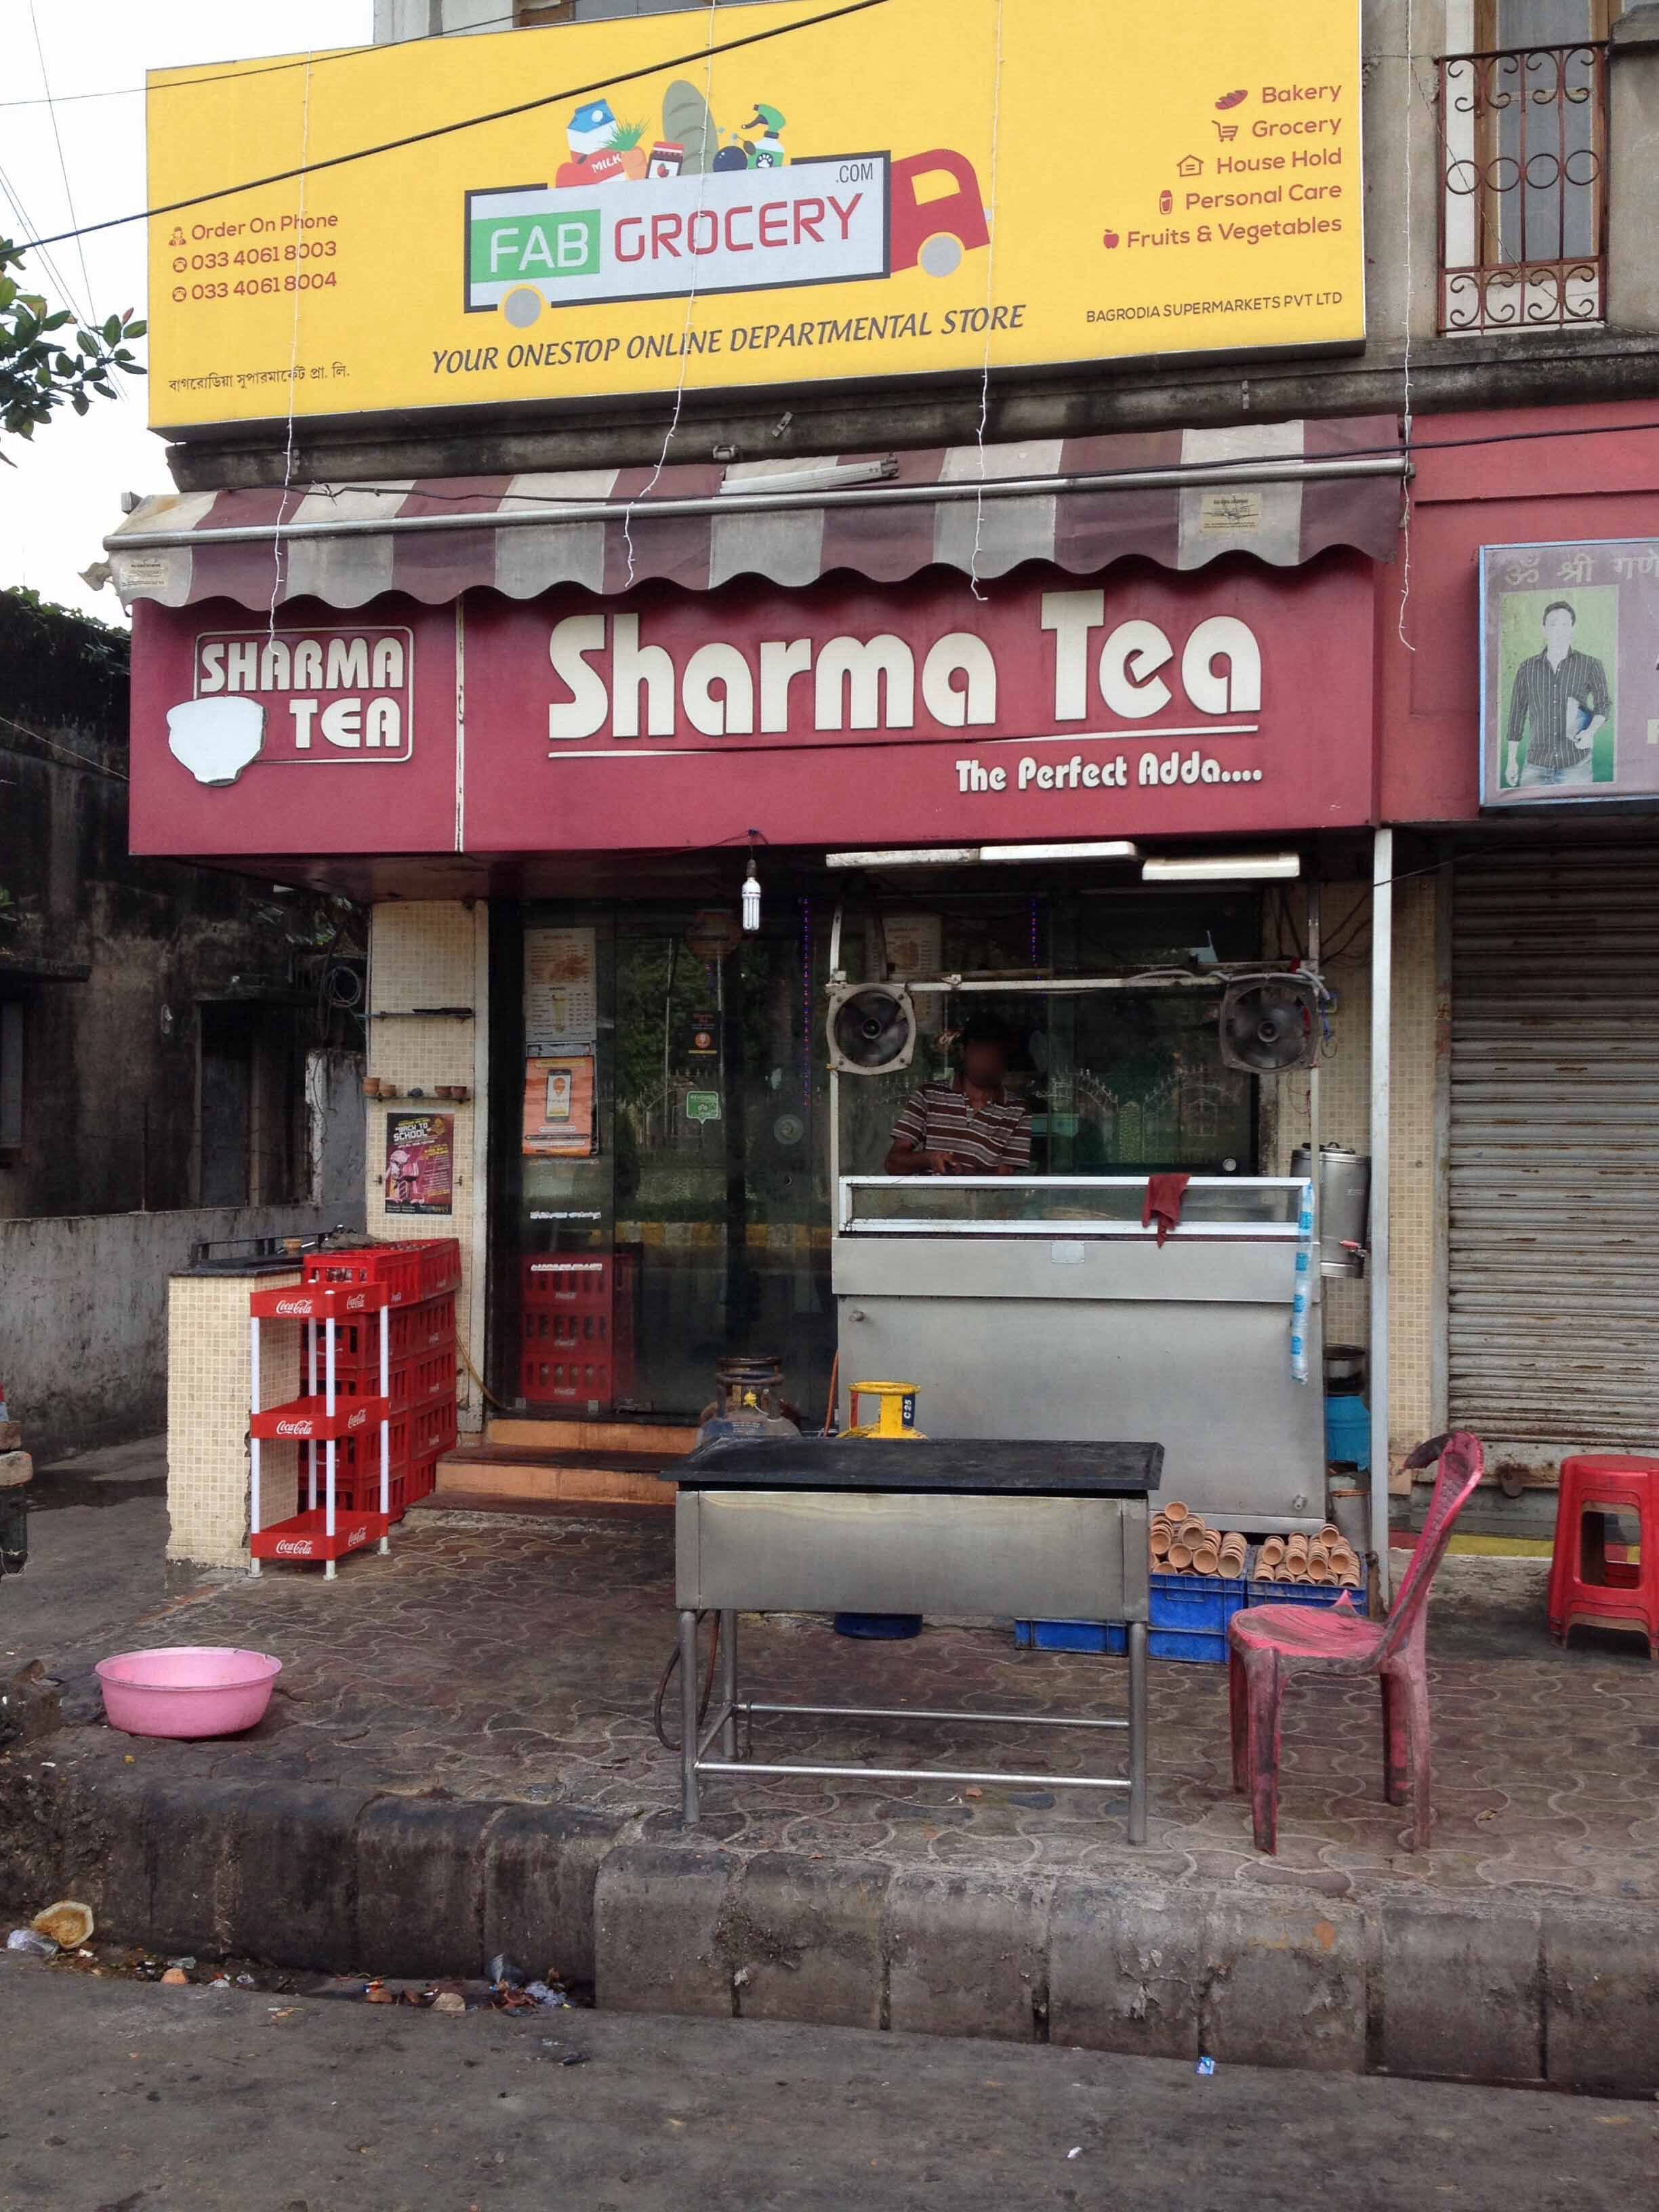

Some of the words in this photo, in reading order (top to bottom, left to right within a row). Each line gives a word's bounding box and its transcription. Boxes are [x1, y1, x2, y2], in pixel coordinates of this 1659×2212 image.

[1262, 85, 1342, 104] Bakery
[1252, 118, 1342, 137] Grocery
[591, 153, 622, 173] MILK
[835, 161, 874, 184] .COM
[1216, 155, 1285, 174] House
[1292, 147, 1342, 168] Hold
[1185, 186, 1282, 210] Personal
[1288, 183, 1342, 201] Care
[191, 223, 245, 240] Order
[249, 218, 276, 233] On
[281, 213, 338, 230] Phone
[490, 222, 589, 272] FAB
[614, 193, 863, 262] GROCERY
[1127, 228, 1190, 247] Fruits
[1197, 225, 1212, 242] &
[1218, 216, 1342, 245] Vegetables
[191, 253, 228, 270] 033
[233, 247, 280, 266] 4061
[284, 241, 337, 260] 8003
[191, 283, 228, 300] 033
[233, 276, 280, 295] 4061
[284, 271, 337, 291] 8004
[1086, 304, 1160, 323] BAGRODIA
[1164, 296, 1280, 317] SUPERMARKETS
[1284, 293, 1313, 307] PVT
[1316, 291, 1343, 305] LTD
[432, 346, 498, 374] YOUR
[506, 338, 621, 369] ONESTOP
[627, 329, 722, 359] ONLINE
[730, 312, 933, 352] DEPARTMENTAL
[942, 304, 1026, 334] STORE
[200, 636, 404, 693] SHARMA
[548, 612, 997, 740] Sharma
[1041, 588, 1262, 721] Tea
[289, 697, 401, 748] TEA
[956, 758, 1007, 794] The
[1018, 756, 1127, 791] Perfect
